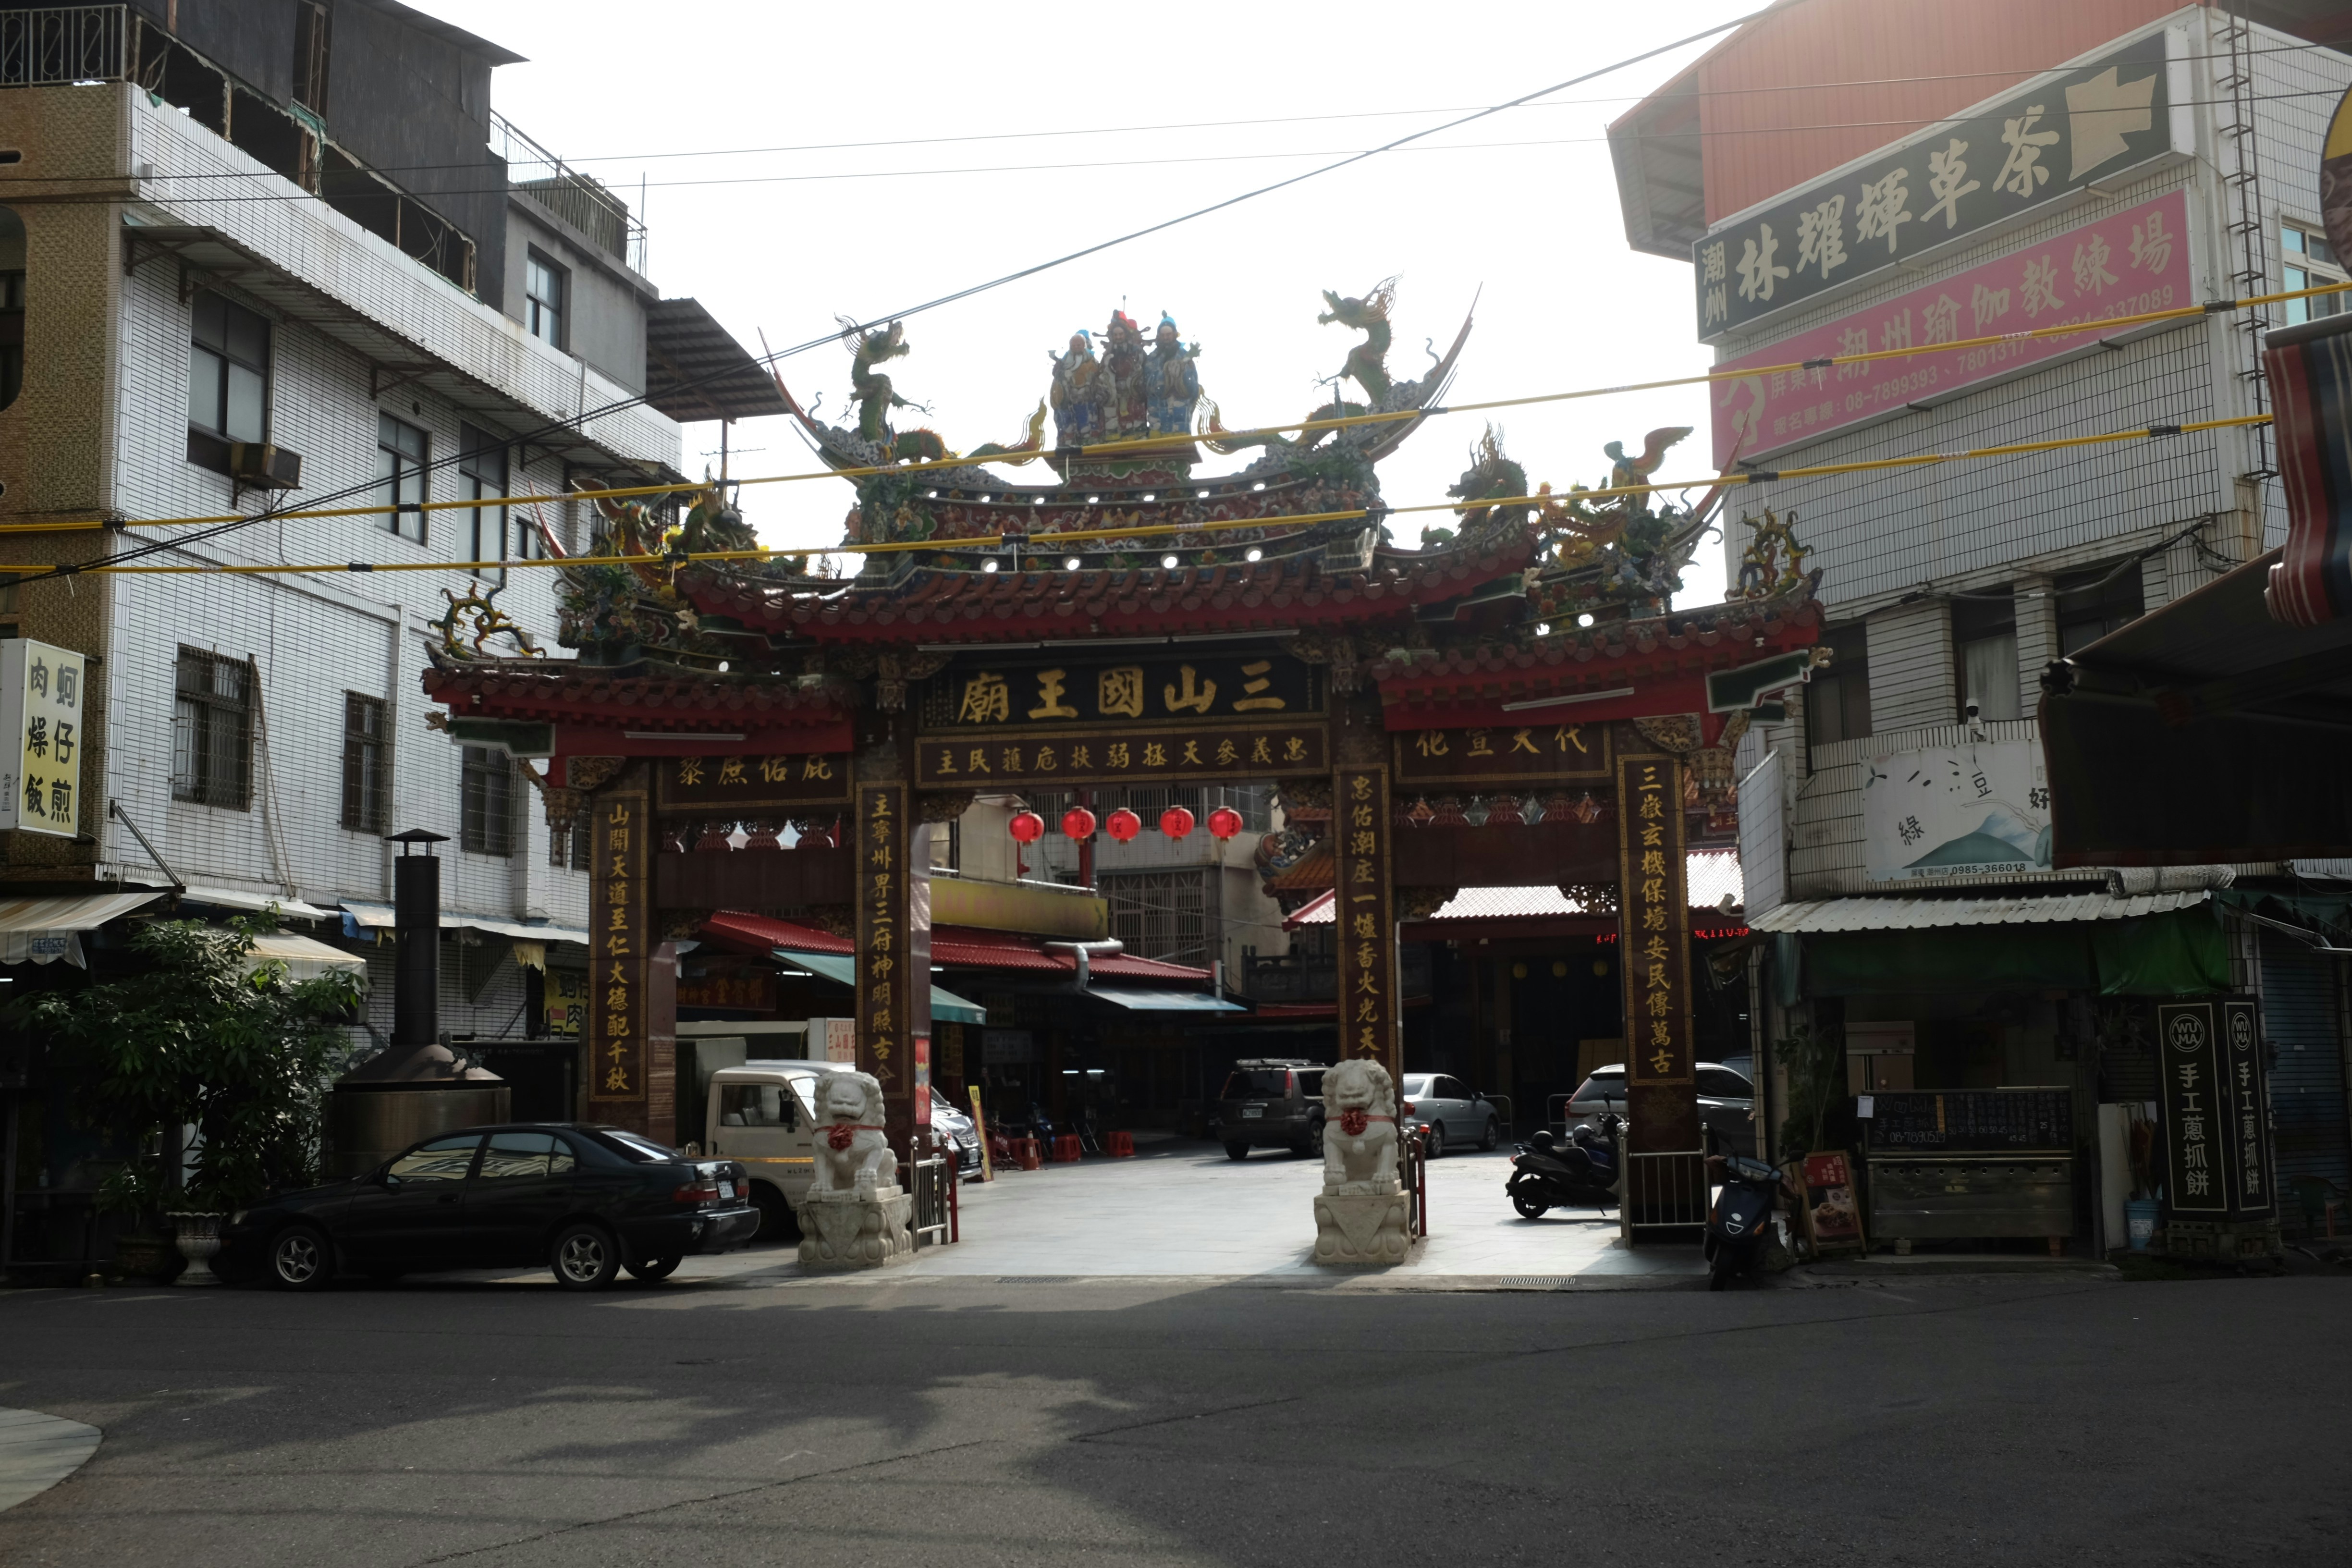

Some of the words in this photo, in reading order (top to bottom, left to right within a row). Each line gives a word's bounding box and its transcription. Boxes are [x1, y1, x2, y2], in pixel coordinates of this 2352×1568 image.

[1702, 241, 1727, 328] 潮州
[25, 656, 49, 817] 肉燥飯
[50, 663, 78, 824] 蚵仔煎
[1350, 775, 1382, 1060] 忠佑潮庄一爐香火光天
[1638, 766, 1675, 1074] 三嶽玄機保境安民傳萬古
[1952, 863, 2026, 875] 0985-366018
[605, 803, 631, 1091] 山開天道至仁大德配千秋
[2175, 1022, 2199, 1033] WU
[2177, 1034, 2198, 1045] MA
[2234, 1021, 2248, 1031] WU
[2236, 1031, 2248, 1043] MA
[2178, 1062, 2210, 1196] 手工蔥抓餅
[2237, 1060, 2260, 1195] 手工蔥抓餅
